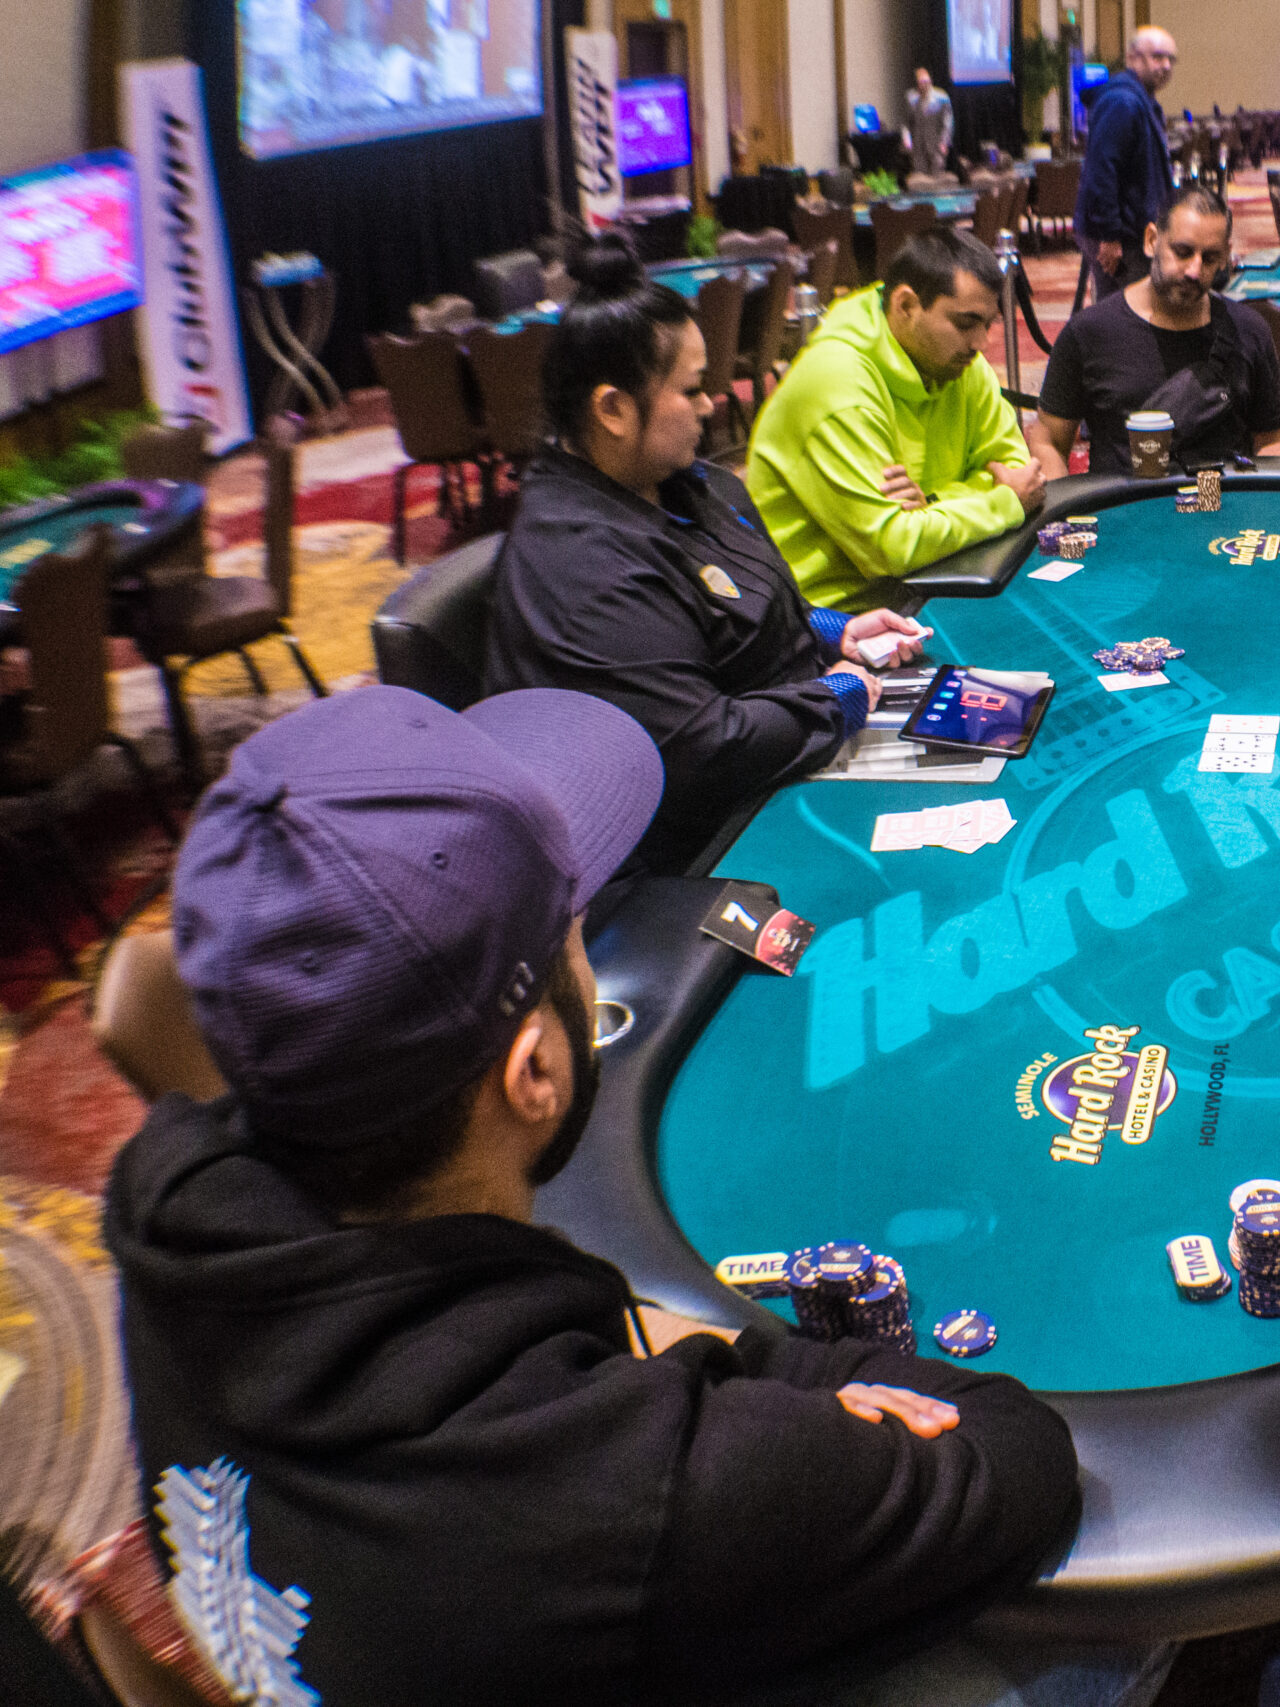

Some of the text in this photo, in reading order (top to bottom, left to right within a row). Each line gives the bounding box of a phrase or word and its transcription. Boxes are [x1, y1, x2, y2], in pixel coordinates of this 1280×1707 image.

[720, 901, 759, 932] 7
[797, 789, 1189, 1091] Hard
[1015, 1051, 1058, 1120] SEMINOLE
[1050, 1023, 1141, 1165] Hard Rock
[1129, 1048, 1160, 1139] HOTEL & CASINO
[1199, 1043, 1231, 1146] HOLLYWOOD, FL
[726, 1260, 783, 1276] TIME
[1181, 1238, 1210, 1281] TIME
